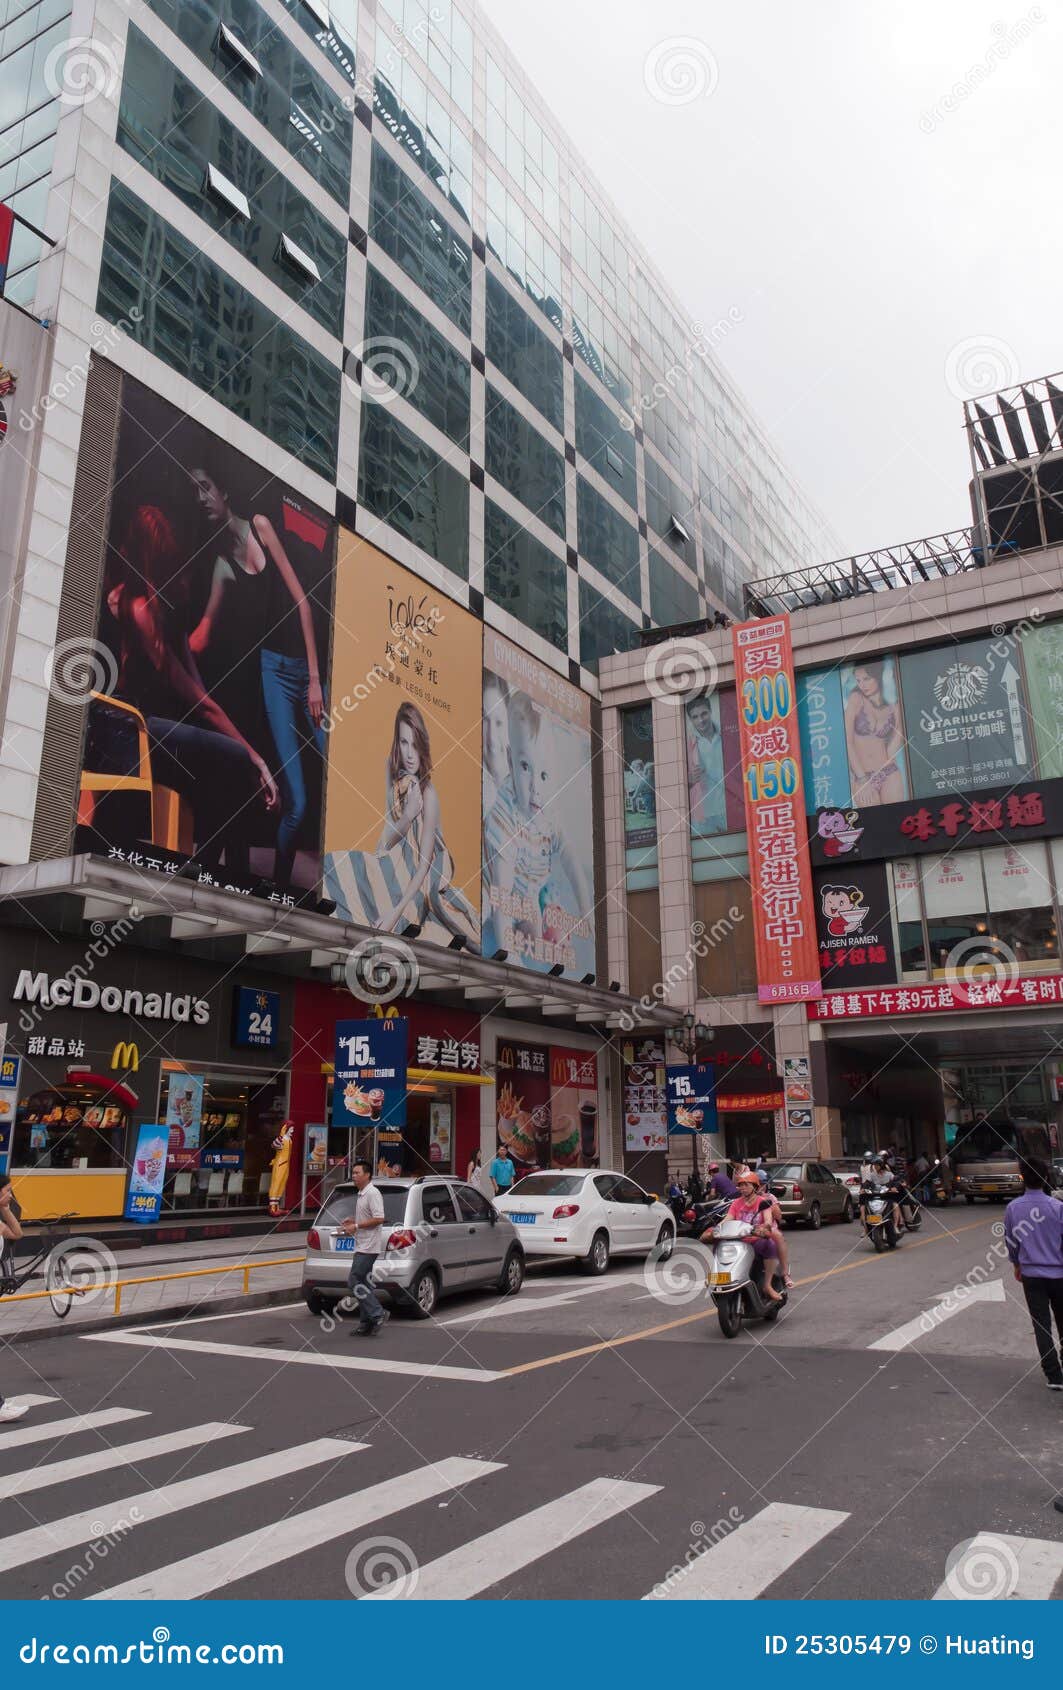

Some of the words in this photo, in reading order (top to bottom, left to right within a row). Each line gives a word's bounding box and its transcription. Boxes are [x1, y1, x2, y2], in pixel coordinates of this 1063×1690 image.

[743, 670, 792, 726] 300
[929, 719, 1007, 747] 星巴克咖啡
[747, 757, 799, 802] 150
[819, 939, 848, 949] AJISEN
[848, 935, 879, 946] RAMEN
[13, 969, 210, 1025] McDonald's
[771, 984, 810, 997] 6月16日
[247, 1012, 273, 1036] 24
[27, 1036, 86, 1059] 甜品站
[417, 1035, 481, 1070] 麦当劳
